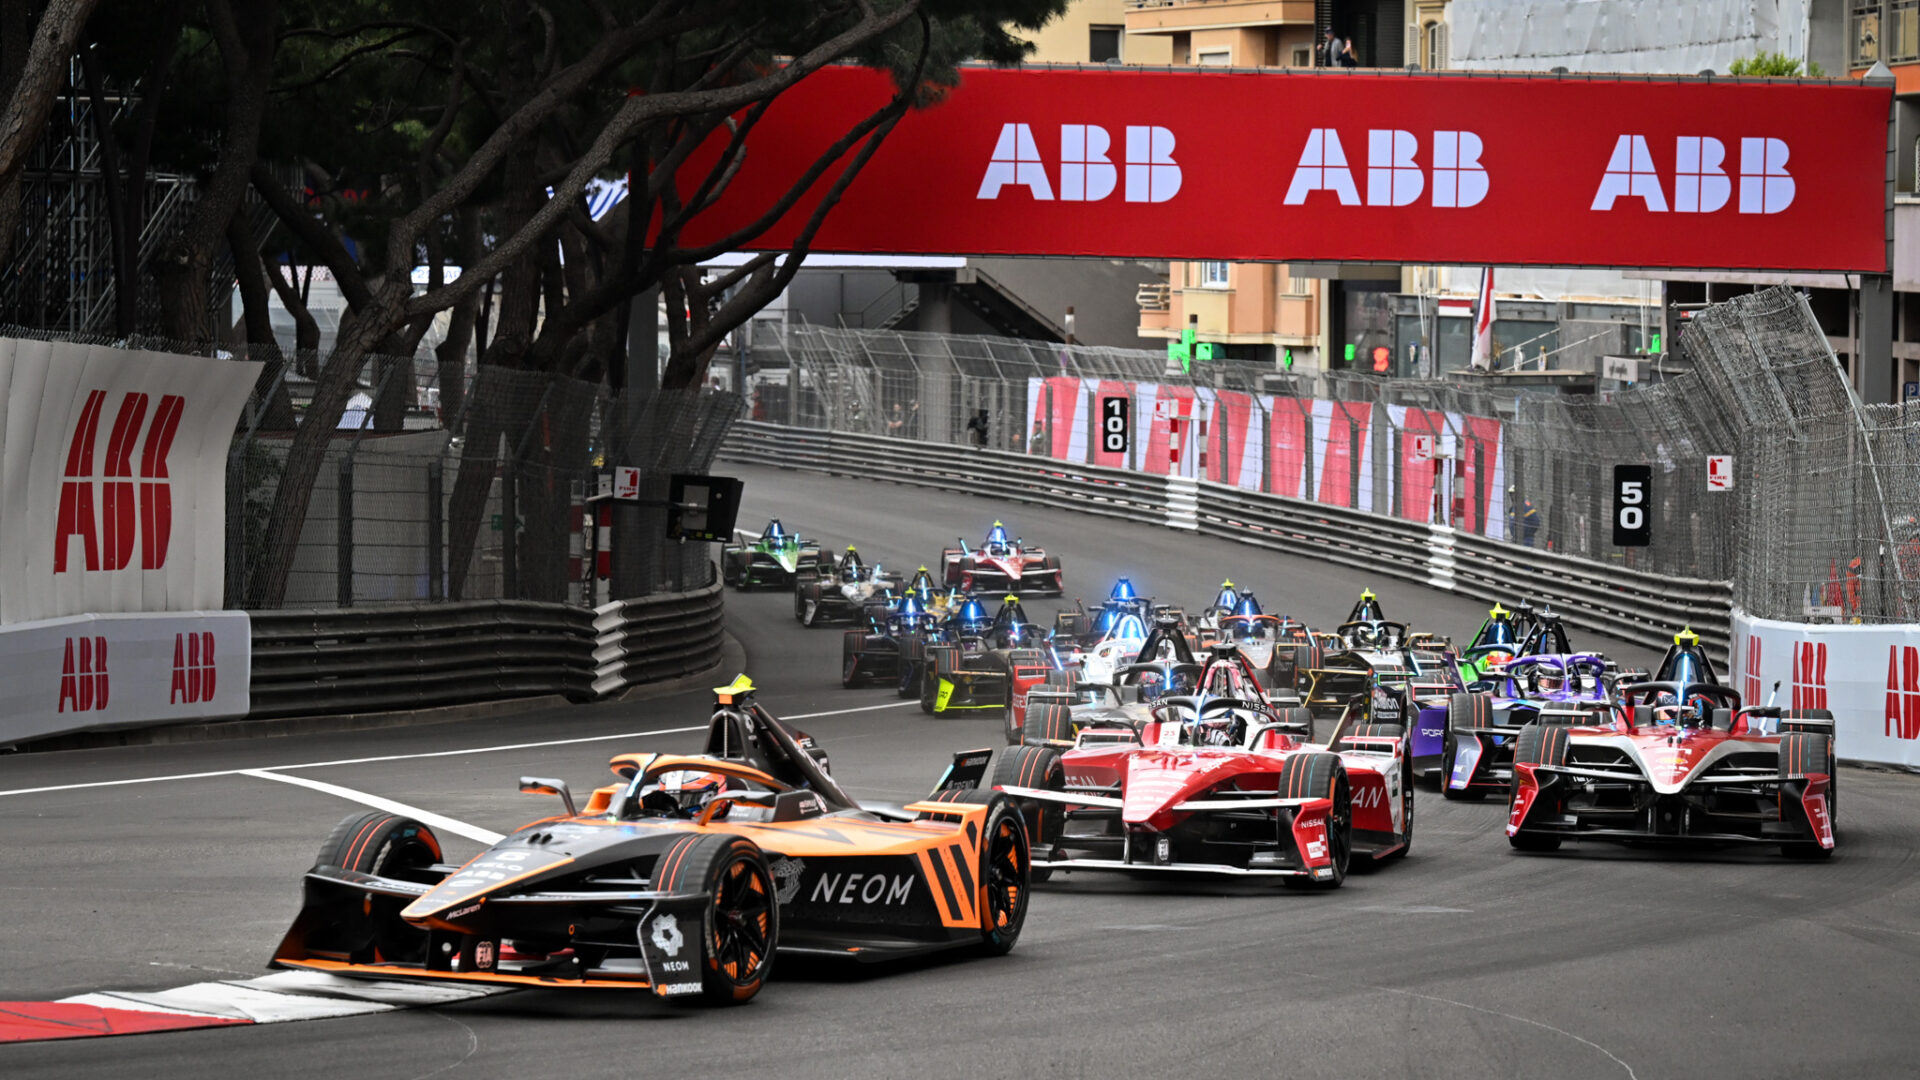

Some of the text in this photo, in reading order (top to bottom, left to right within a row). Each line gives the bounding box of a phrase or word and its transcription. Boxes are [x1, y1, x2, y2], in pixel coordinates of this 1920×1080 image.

[978, 123, 1182, 203] ABB
[1284, 128, 1490, 208] ABB
[1591, 134, 1796, 214] ABB
[54, 389, 185, 573] ABB
[1620, 481, 1643, 530] 50
[59, 636, 109, 713] ABB
[171, 631, 216, 705] ABB
[1791, 641, 1828, 710] ABB
[1884, 644, 1920, 741] AB
[810, 872, 915, 906] NEOM
[662, 960, 689, 972] NEOM
